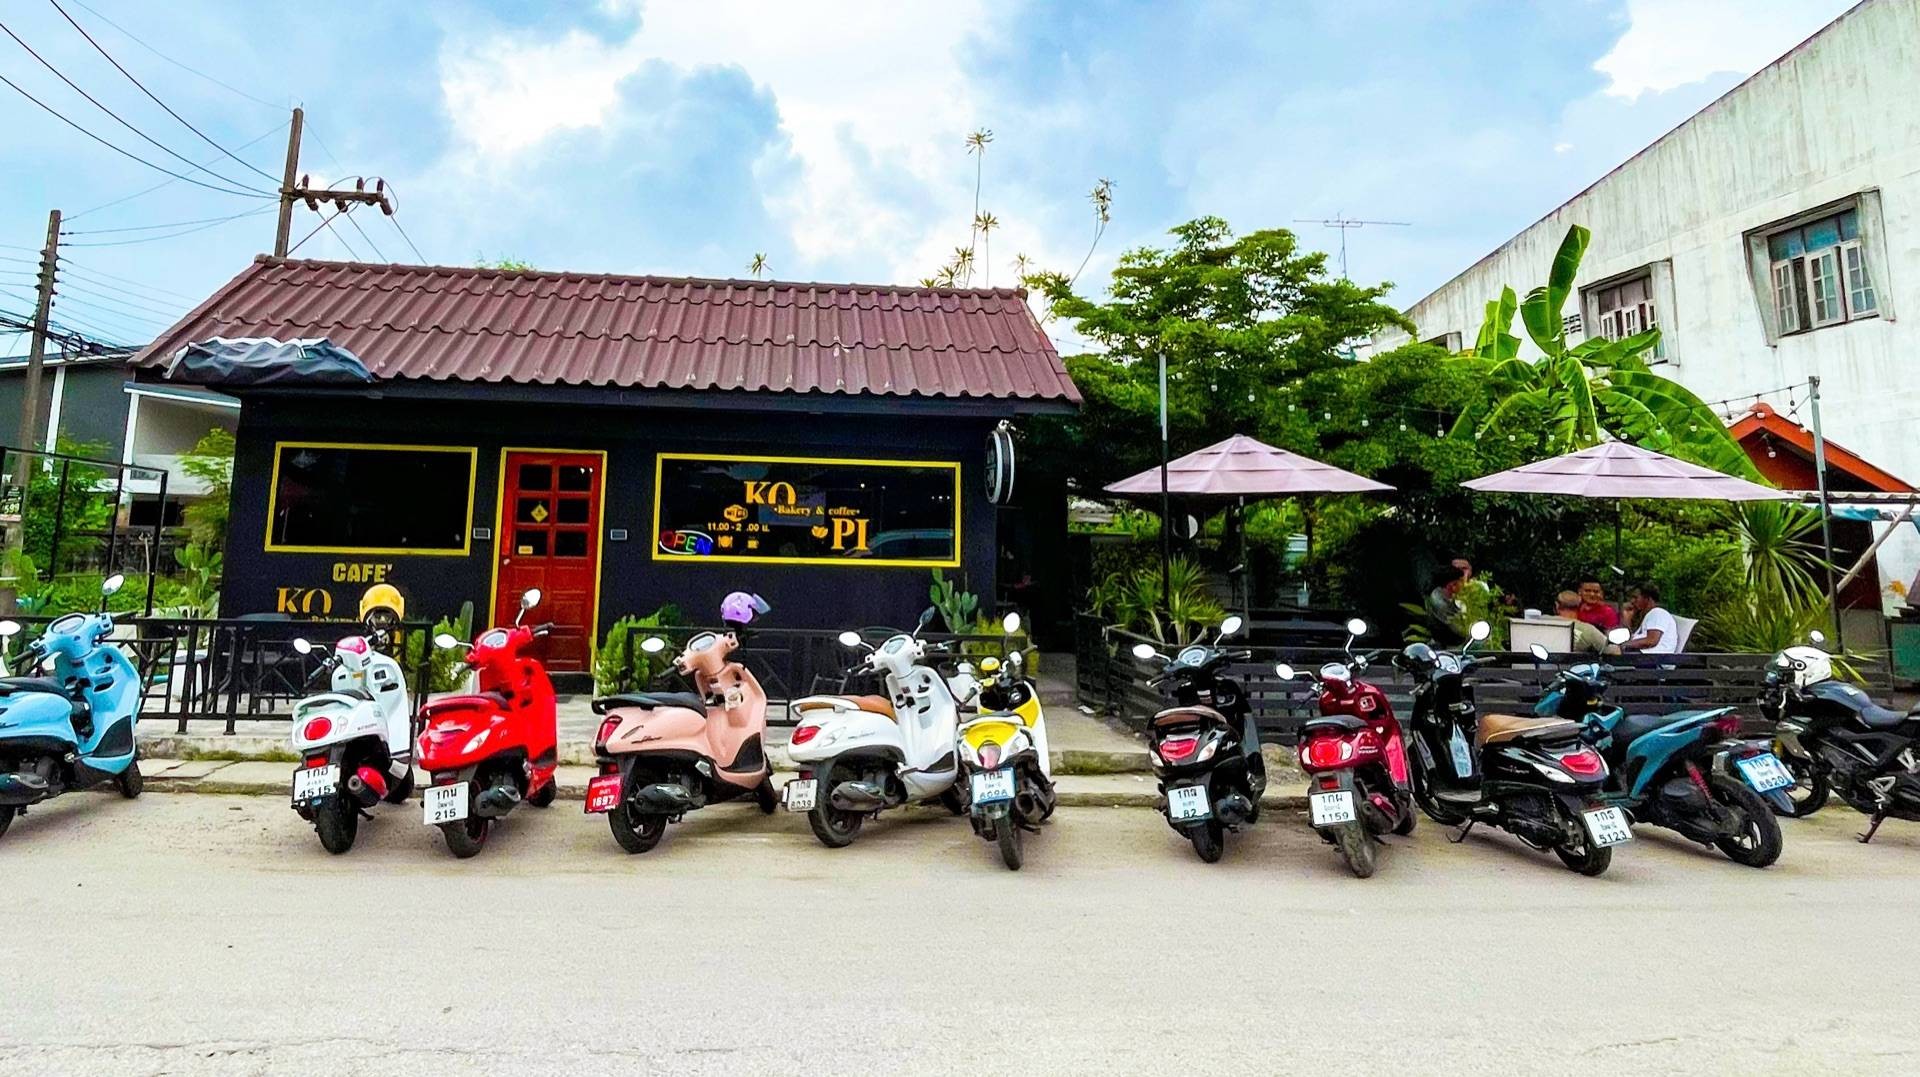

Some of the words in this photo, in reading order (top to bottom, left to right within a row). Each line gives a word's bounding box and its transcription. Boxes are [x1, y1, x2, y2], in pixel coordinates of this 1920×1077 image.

[815, 505, 825, 516] &
[707, 522, 730, 532] 11.00
[830, 517, 871, 552] PI
[660, 530, 714, 556] OPEN
[299, 784, 332, 800] 4515
[592, 795, 615, 808] 1697
[434, 808, 457, 821] 215
[1321, 811, 1350, 823] 1159
[1598, 829, 1628, 845] 5123
